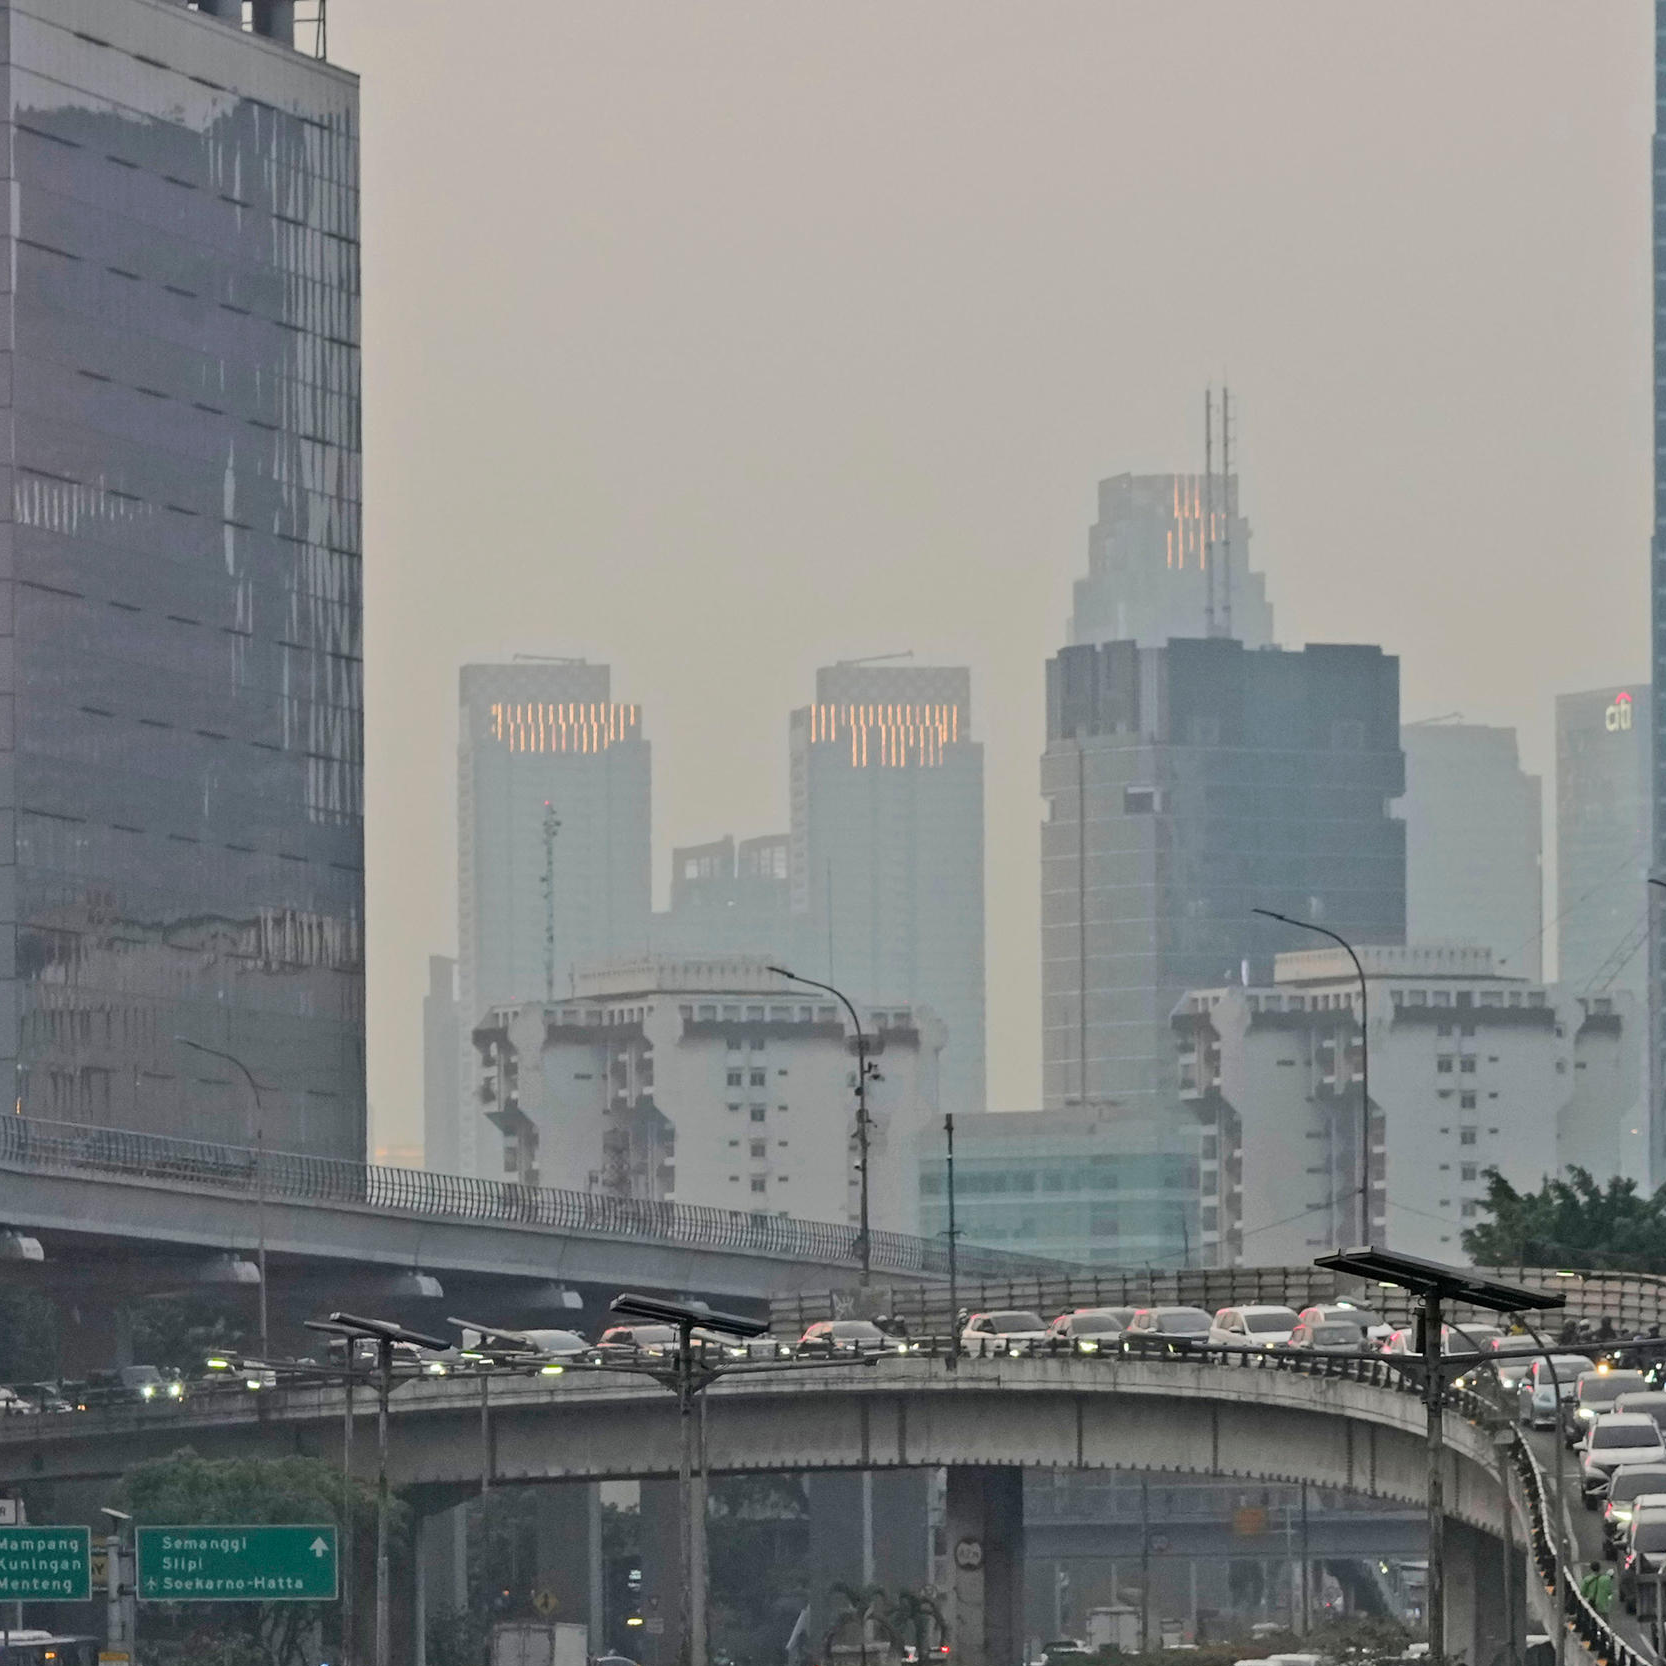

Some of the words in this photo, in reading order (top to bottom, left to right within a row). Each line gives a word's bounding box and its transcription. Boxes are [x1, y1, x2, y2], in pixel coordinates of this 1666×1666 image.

[162, 1537, 247, 1553] Semanggi
[162, 1557, 204, 1572] Slipi
[162, 1575, 305, 1591] Soekarno-Hatta
